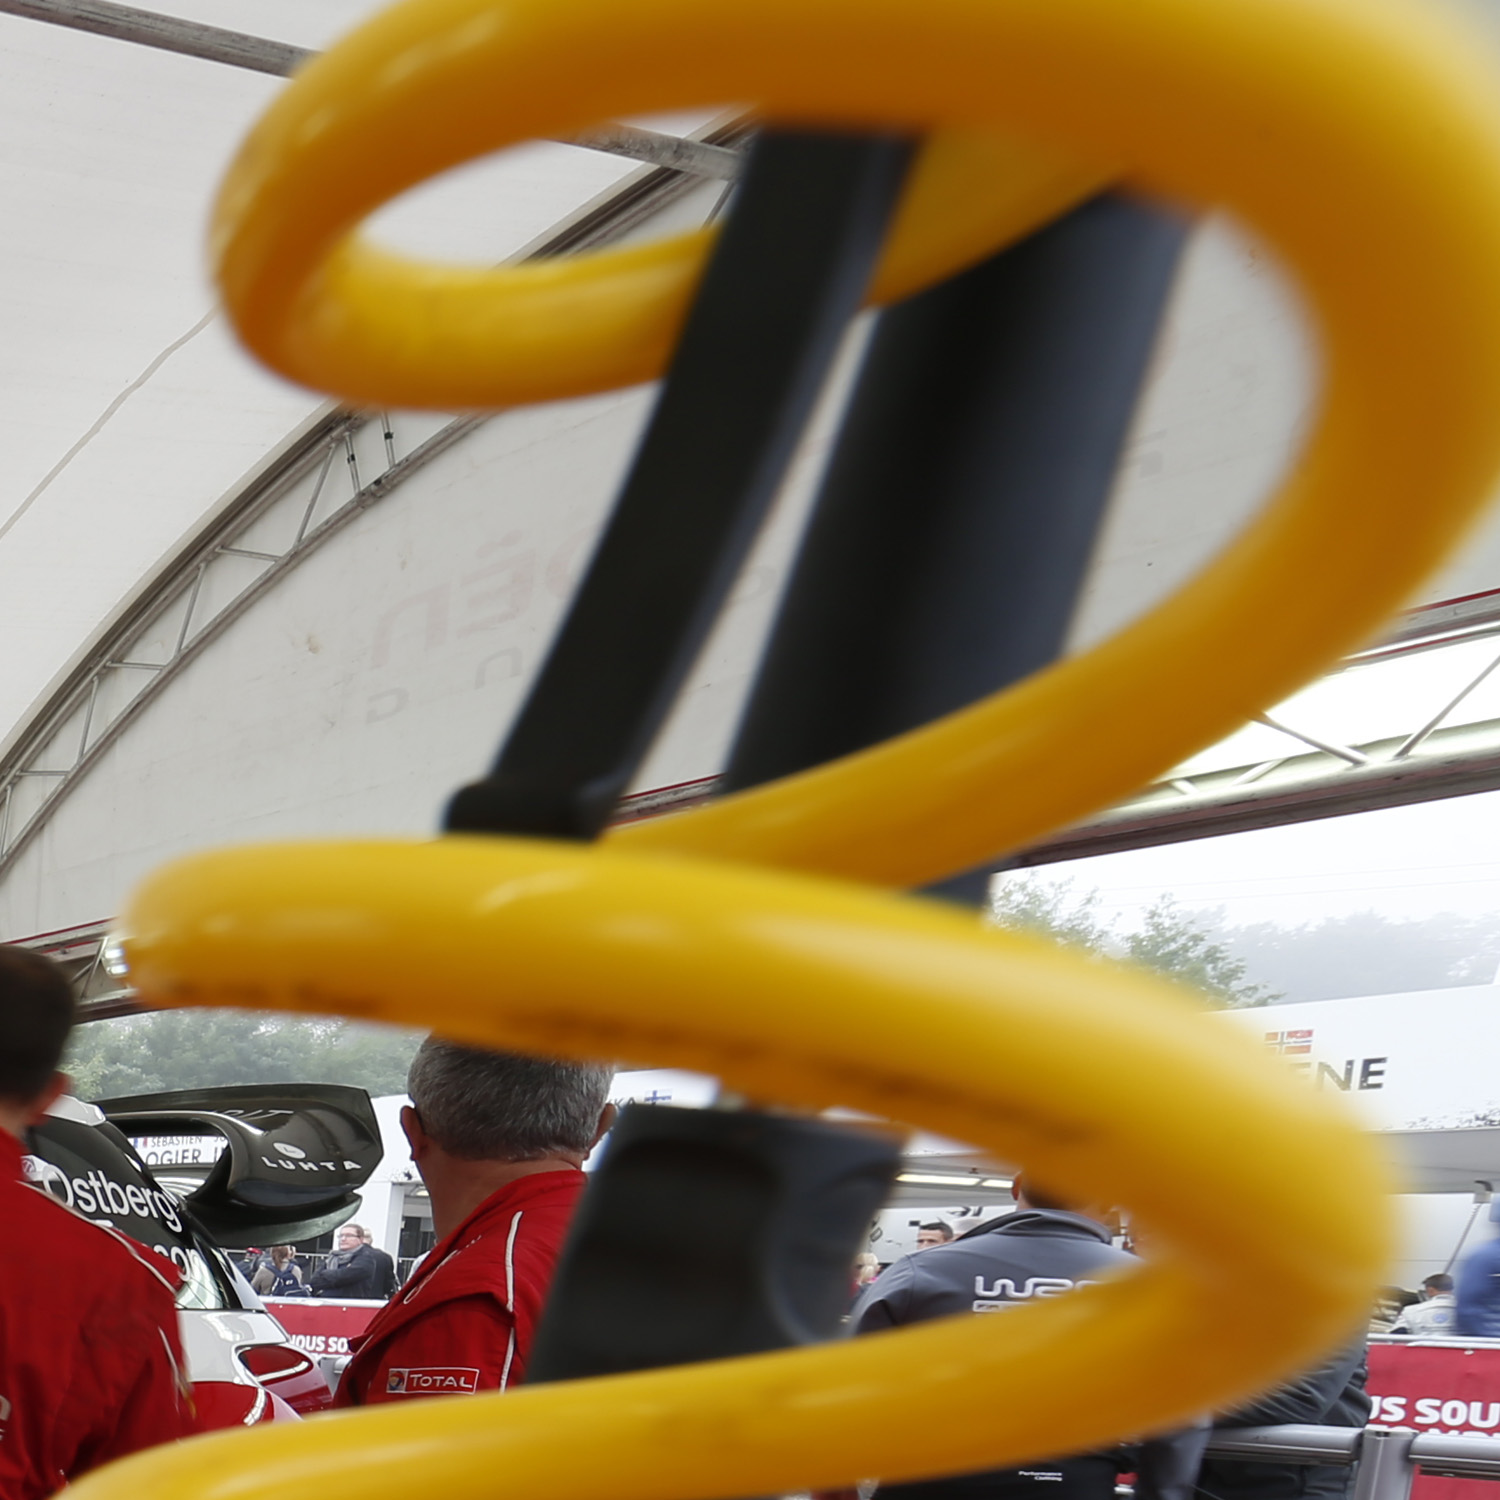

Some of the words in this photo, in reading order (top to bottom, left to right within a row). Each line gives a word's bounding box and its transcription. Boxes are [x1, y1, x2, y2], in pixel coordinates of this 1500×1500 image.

[145, 1148, 201, 1165] OGIER
[260, 1155, 362, 1172] LUHTA
[43, 1166, 182, 1233] Ostberg
[409, 1373, 473, 1389] TOTAL
